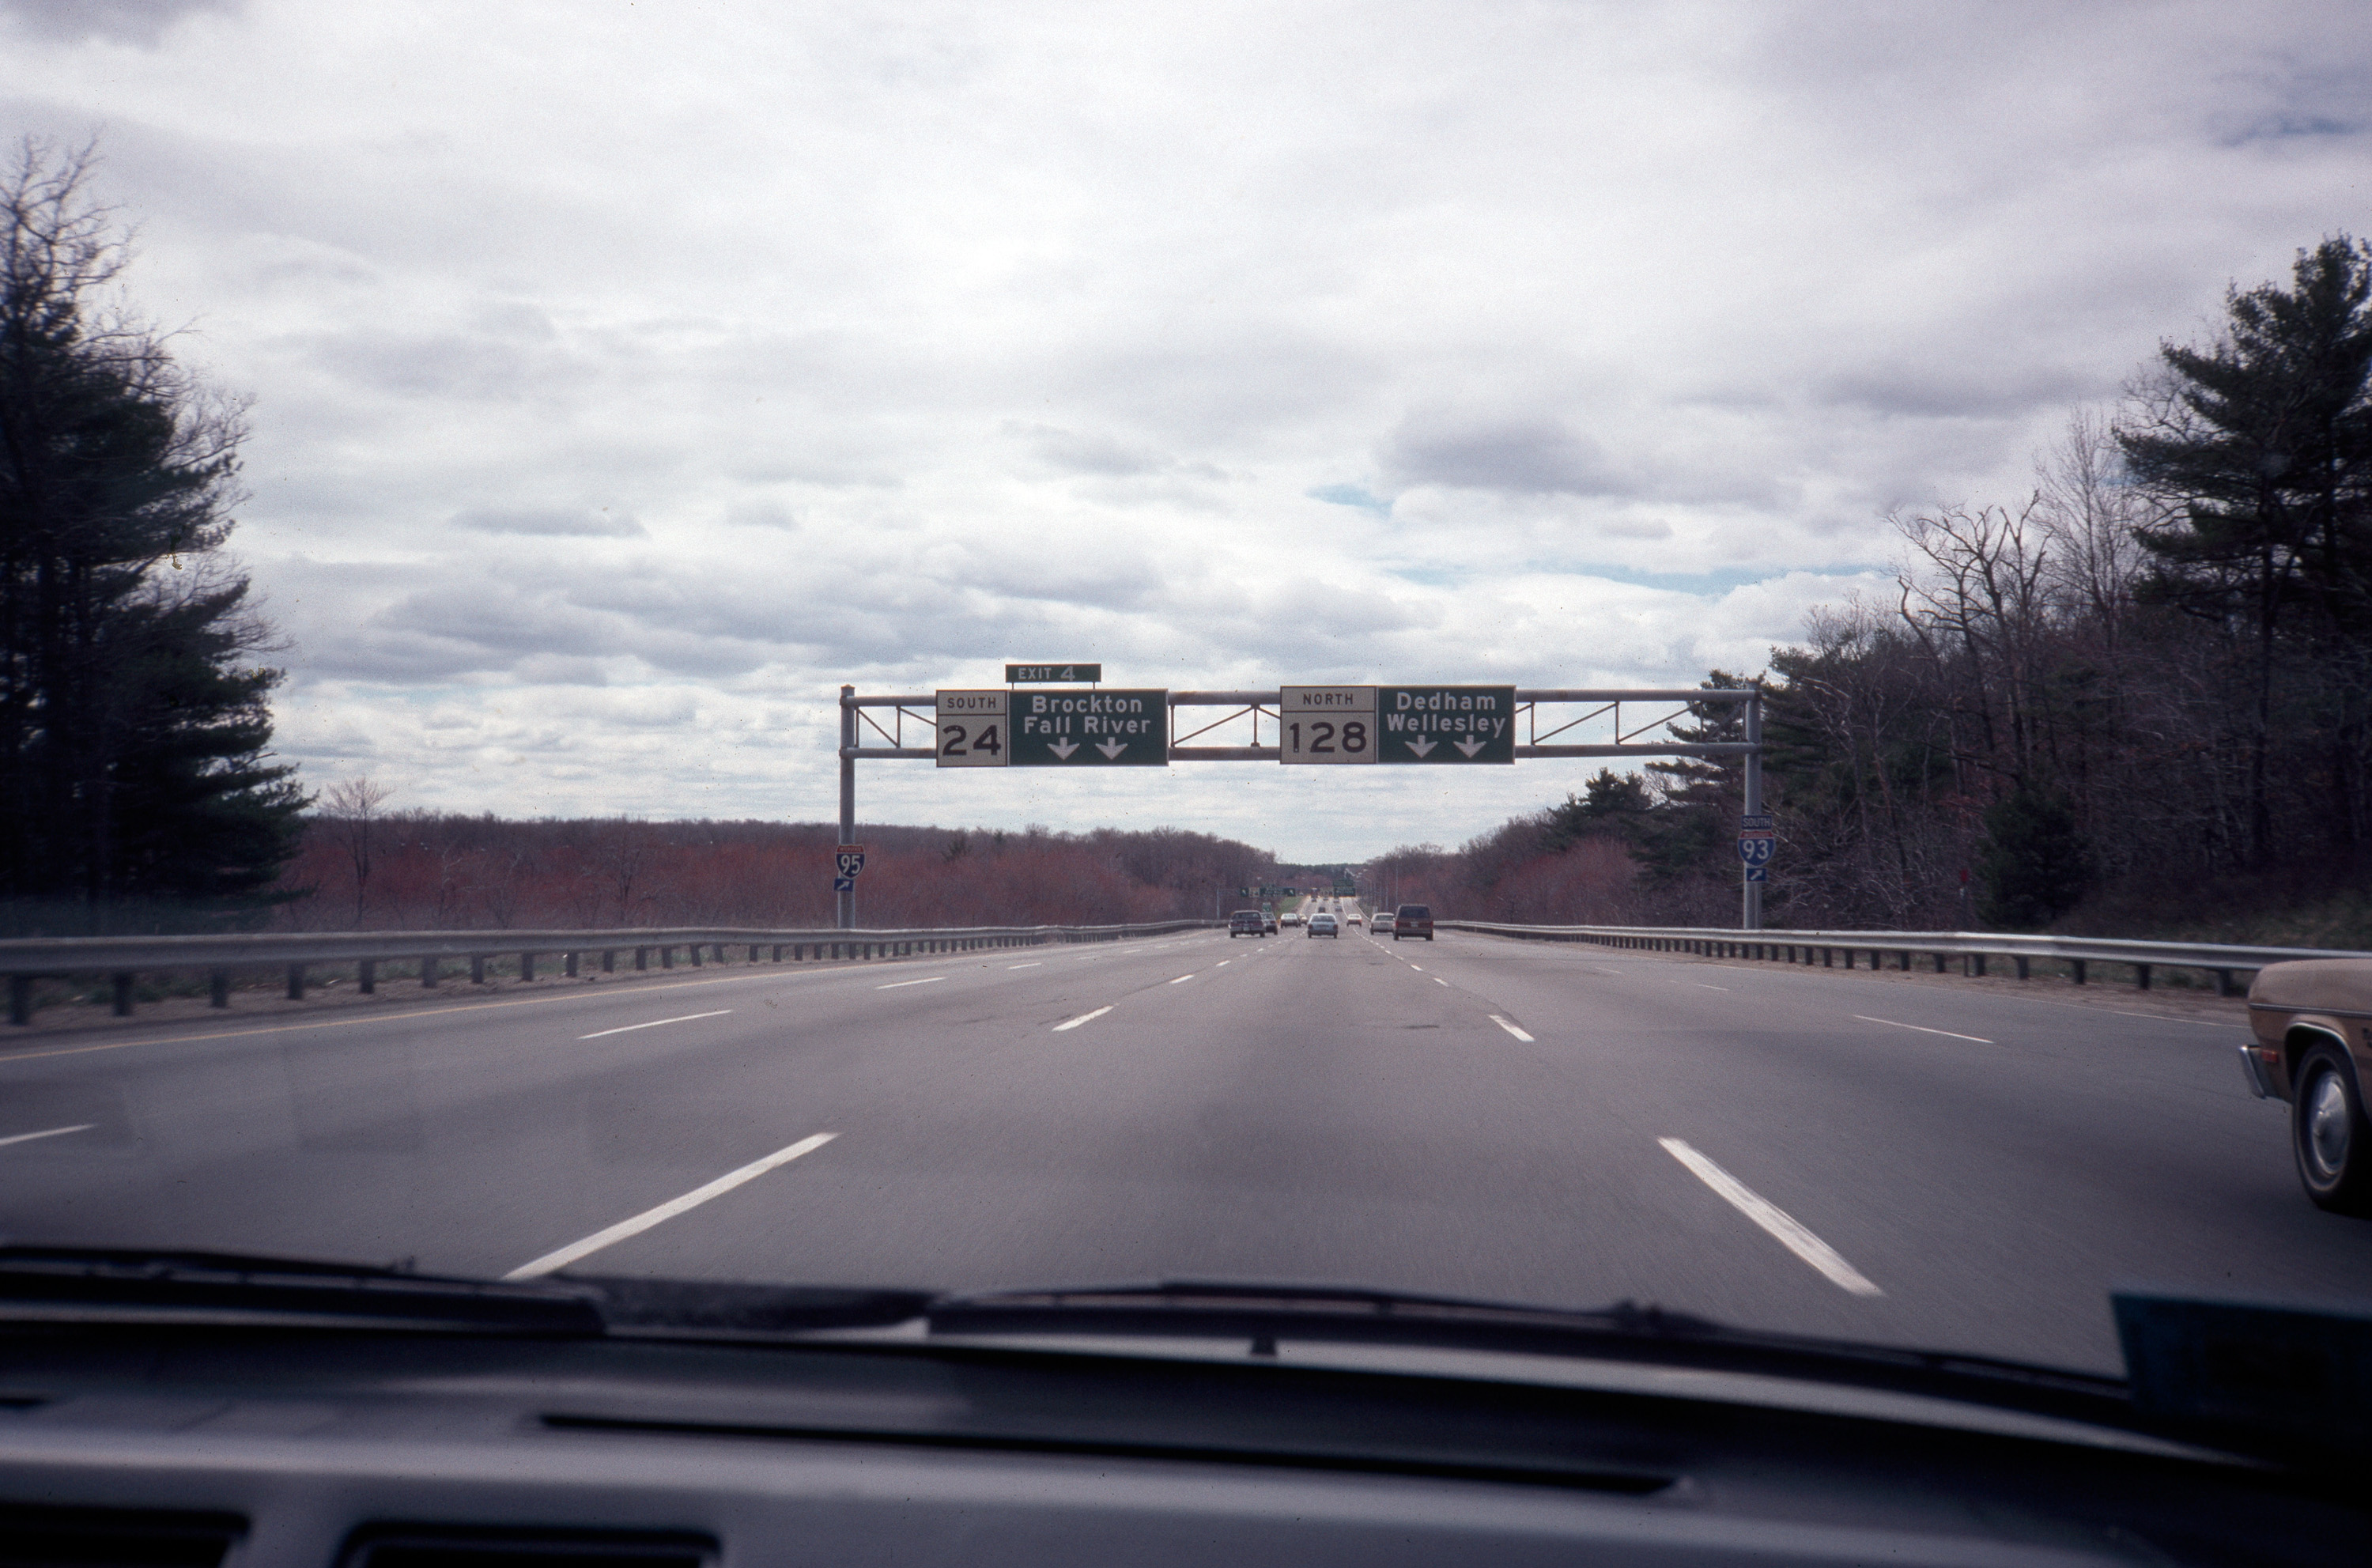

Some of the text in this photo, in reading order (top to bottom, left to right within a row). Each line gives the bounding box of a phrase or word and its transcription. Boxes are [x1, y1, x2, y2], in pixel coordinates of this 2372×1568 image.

[1018, 666, 1075, 681] EXIT 4
[947, 697, 996, 708] SOUTH
[1032, 694, 1143, 713] Brockton
[1303, 693, 1354, 705] NORTH
[1396, 692, 1496, 711] Dedham
[1024, 716, 1150, 734] Fall River
[1386, 713, 1506, 739] Wellesley
[942, 725, 1002, 756] 24
[1289, 721, 1367, 753] 128
[1743, 817, 1770, 827] SOUTH
[1743, 839, 1770, 860] 93
[840, 855, 861, 874] 95
